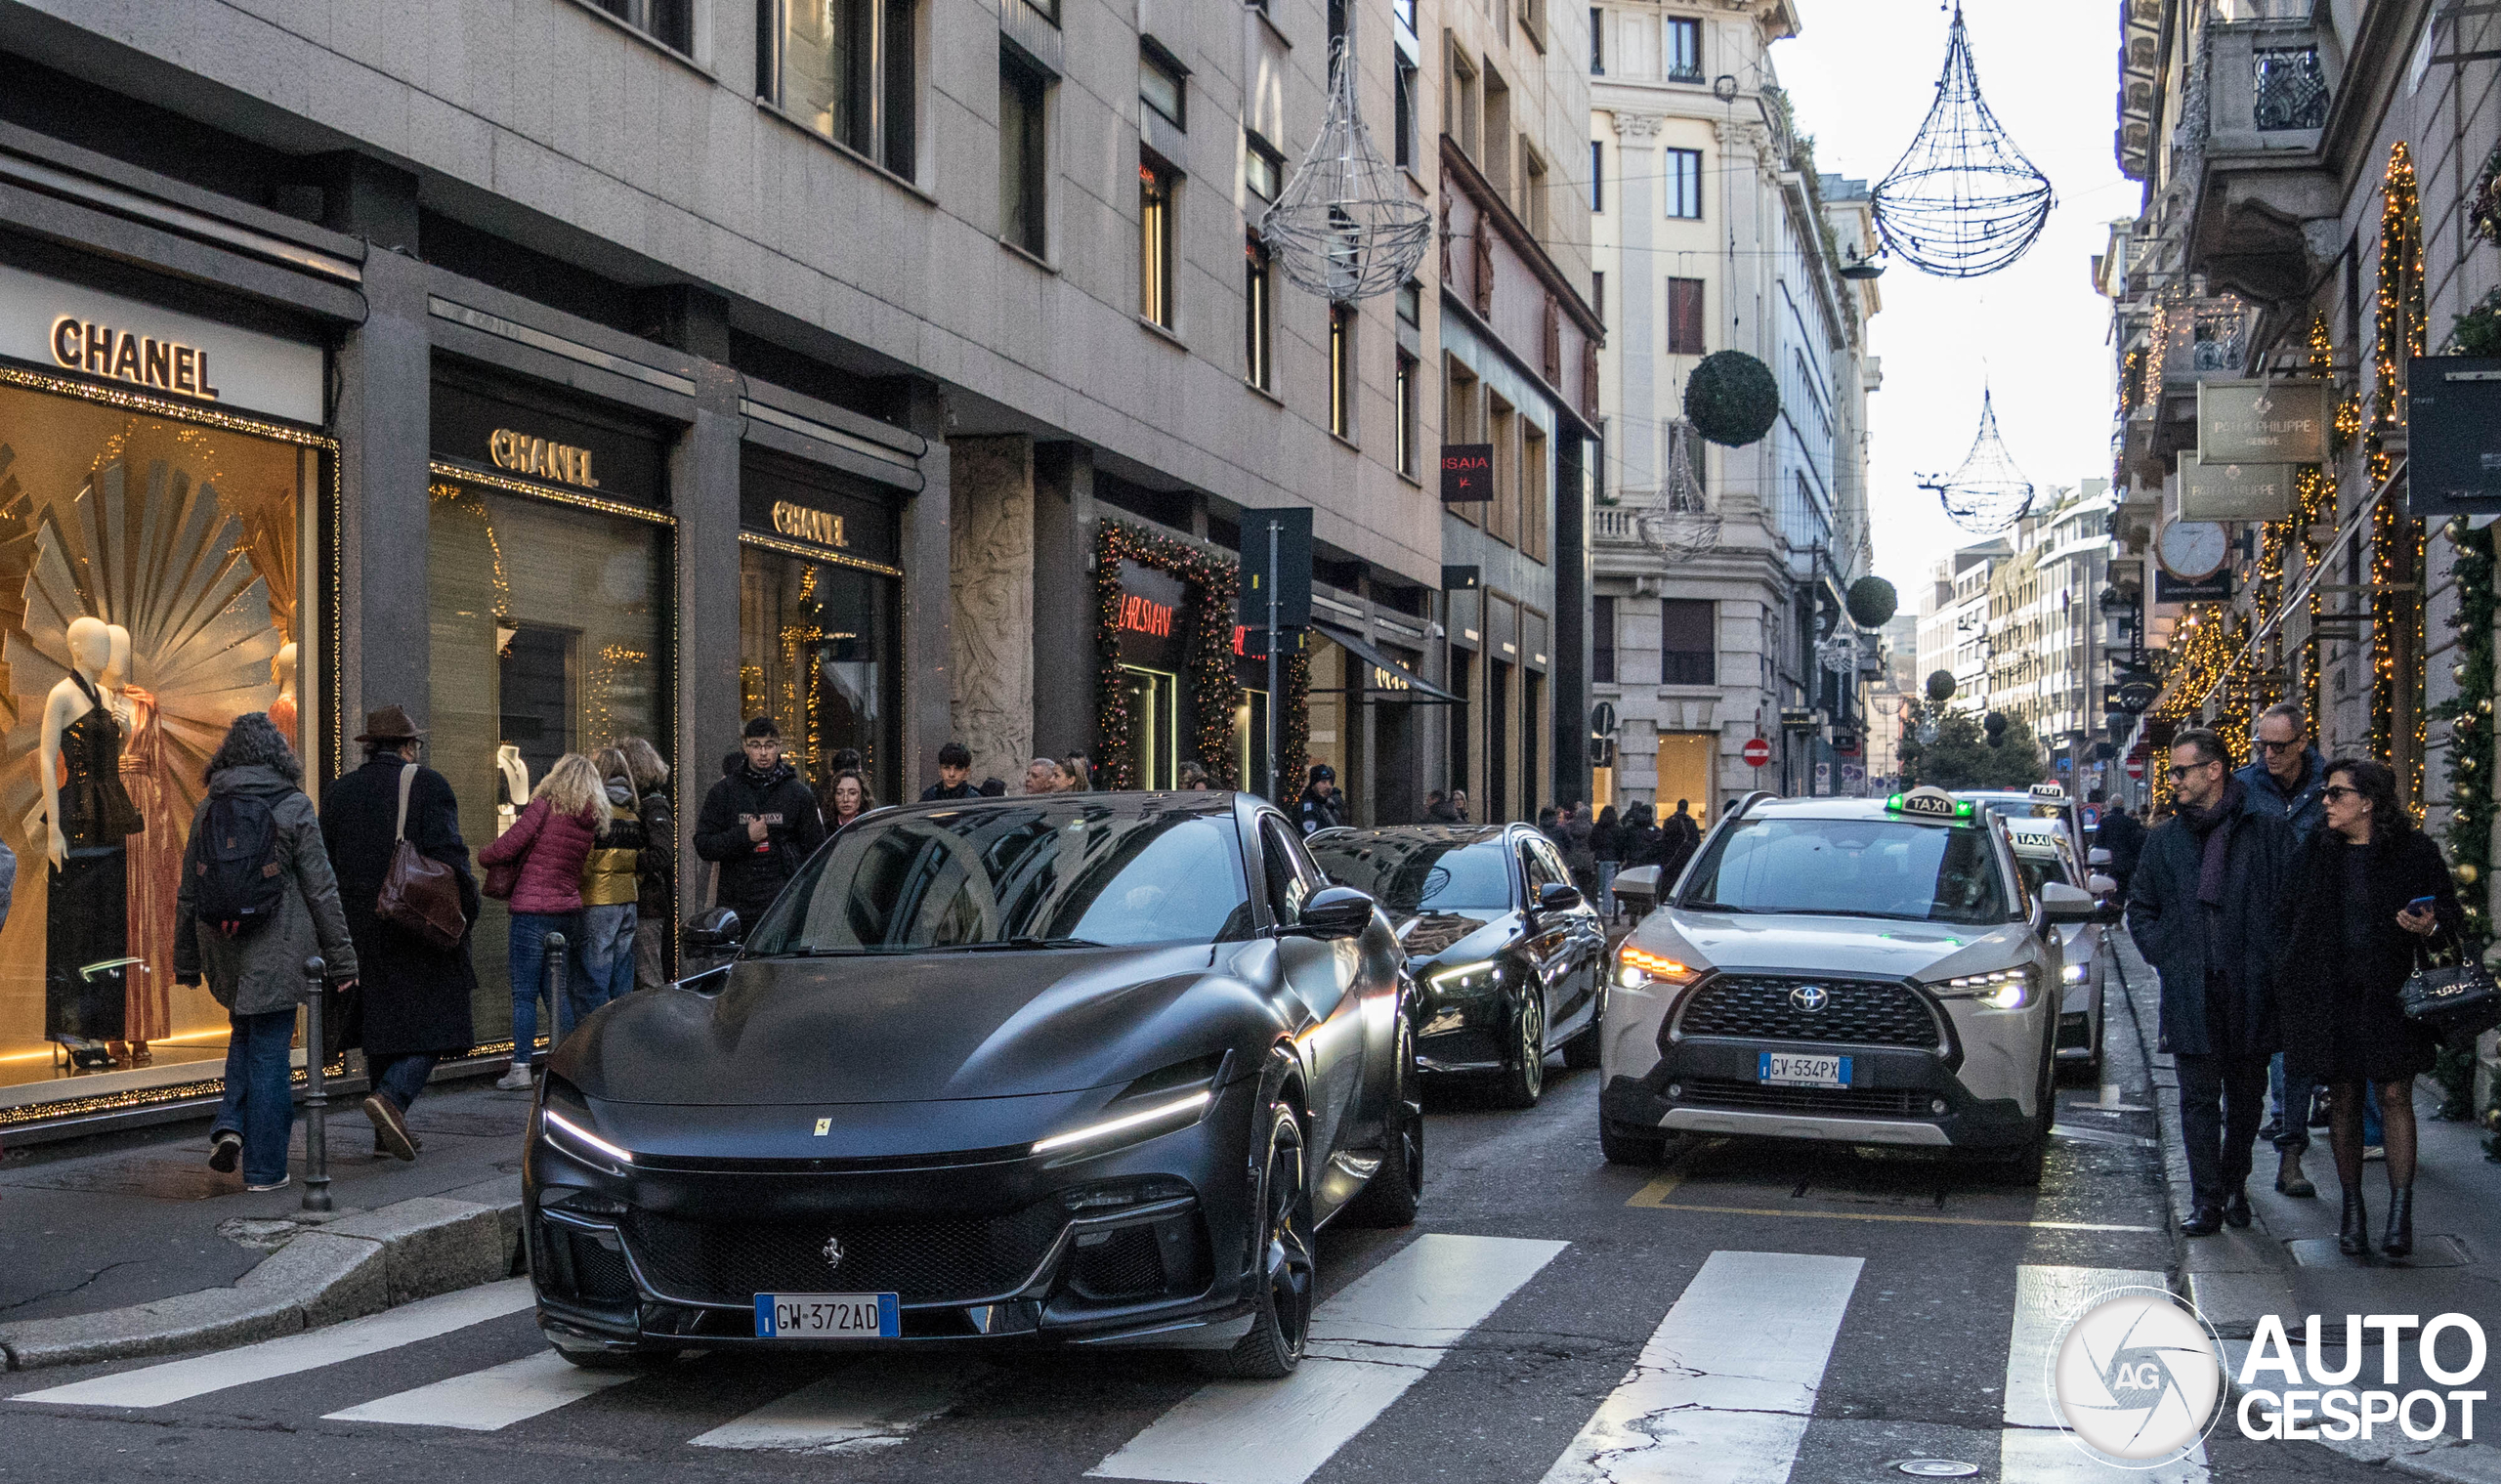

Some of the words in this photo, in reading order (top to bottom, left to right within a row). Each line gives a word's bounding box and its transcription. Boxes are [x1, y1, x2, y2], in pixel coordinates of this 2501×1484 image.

[52, 317, 219, 400] CHANEL
[2256, 419, 2311, 433] PHILIPPE
[490, 429, 599, 488] CHANEL
[1442, 456, 1489, 469] ISAIA
[774, 501, 849, 547] CHANEL
[2036, 786, 2058, 796] TAXI
[1912, 797, 1947, 812] TAXI
[2018, 833, 2050, 845] TAXI
